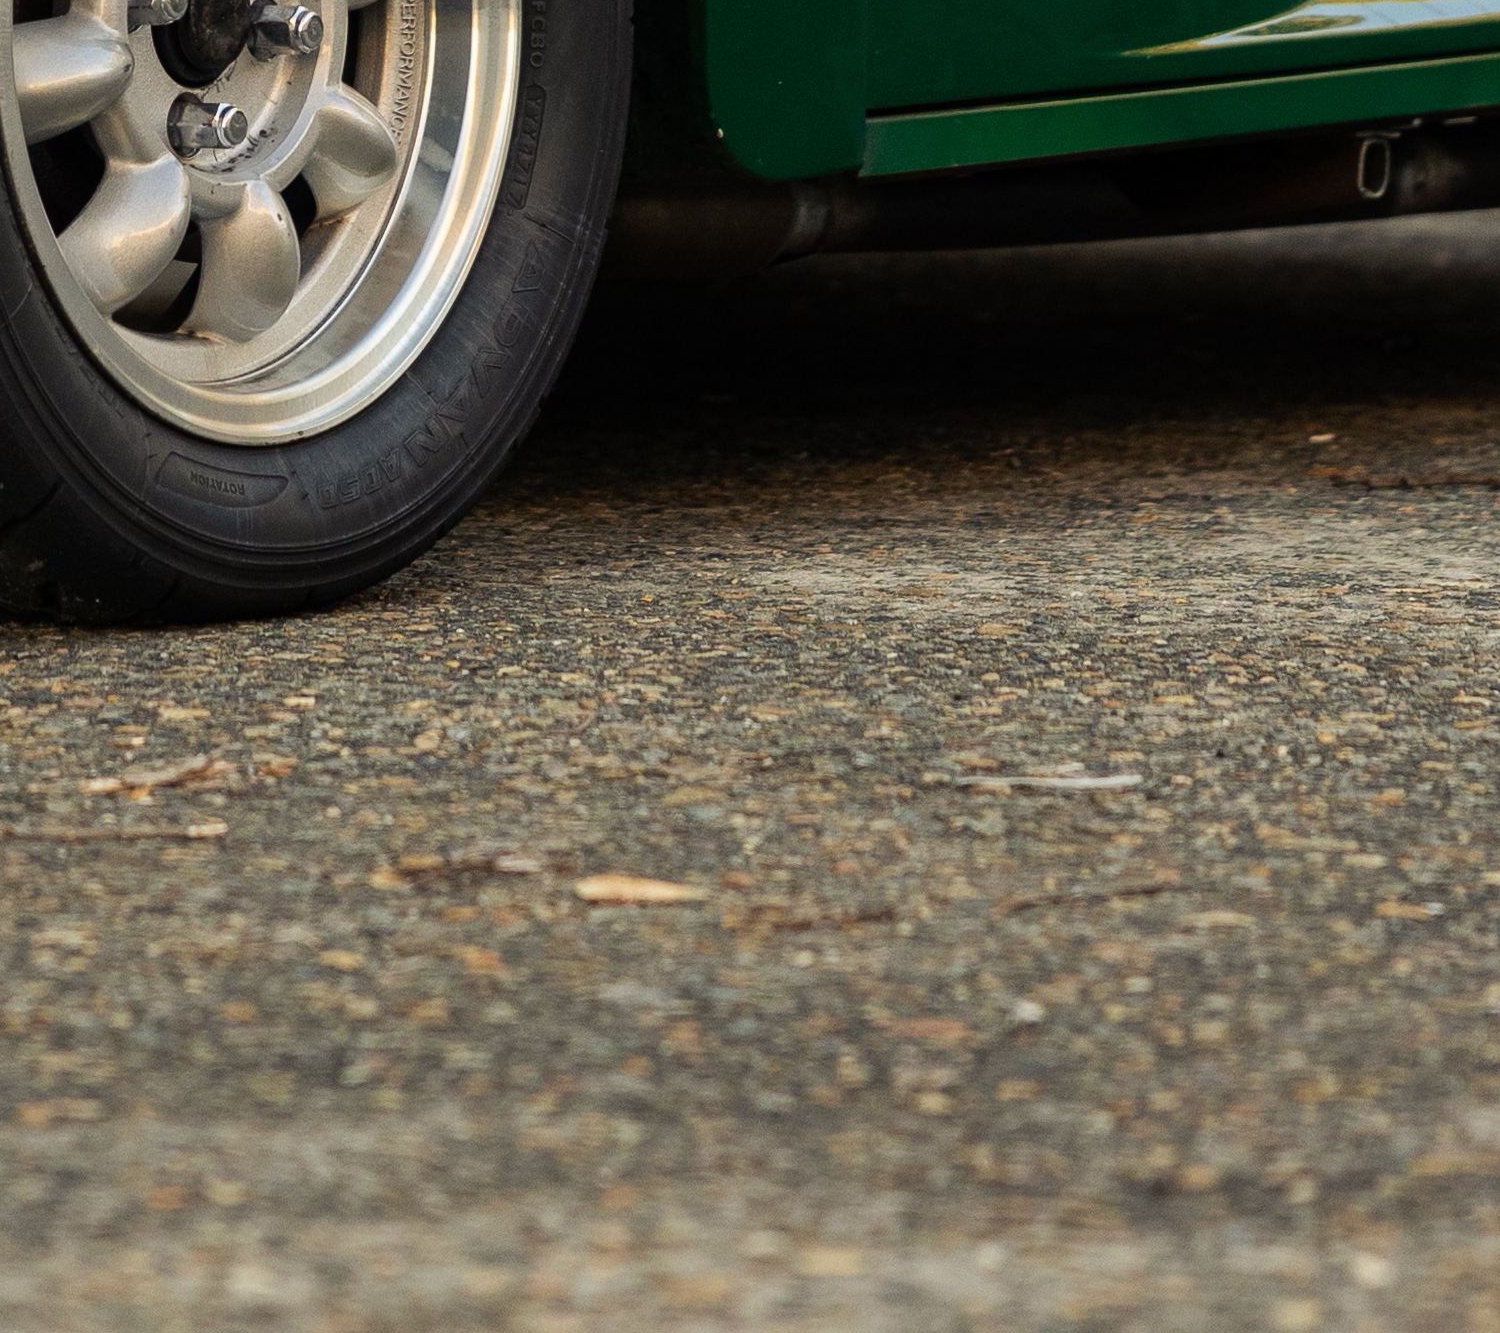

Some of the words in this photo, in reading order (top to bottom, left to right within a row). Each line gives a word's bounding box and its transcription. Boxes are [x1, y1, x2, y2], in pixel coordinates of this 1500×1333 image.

[403, 238, 548, 468] ADVAN
[189, 470, 246, 497] ROTATION
[315, 447, 403, 511] A050
